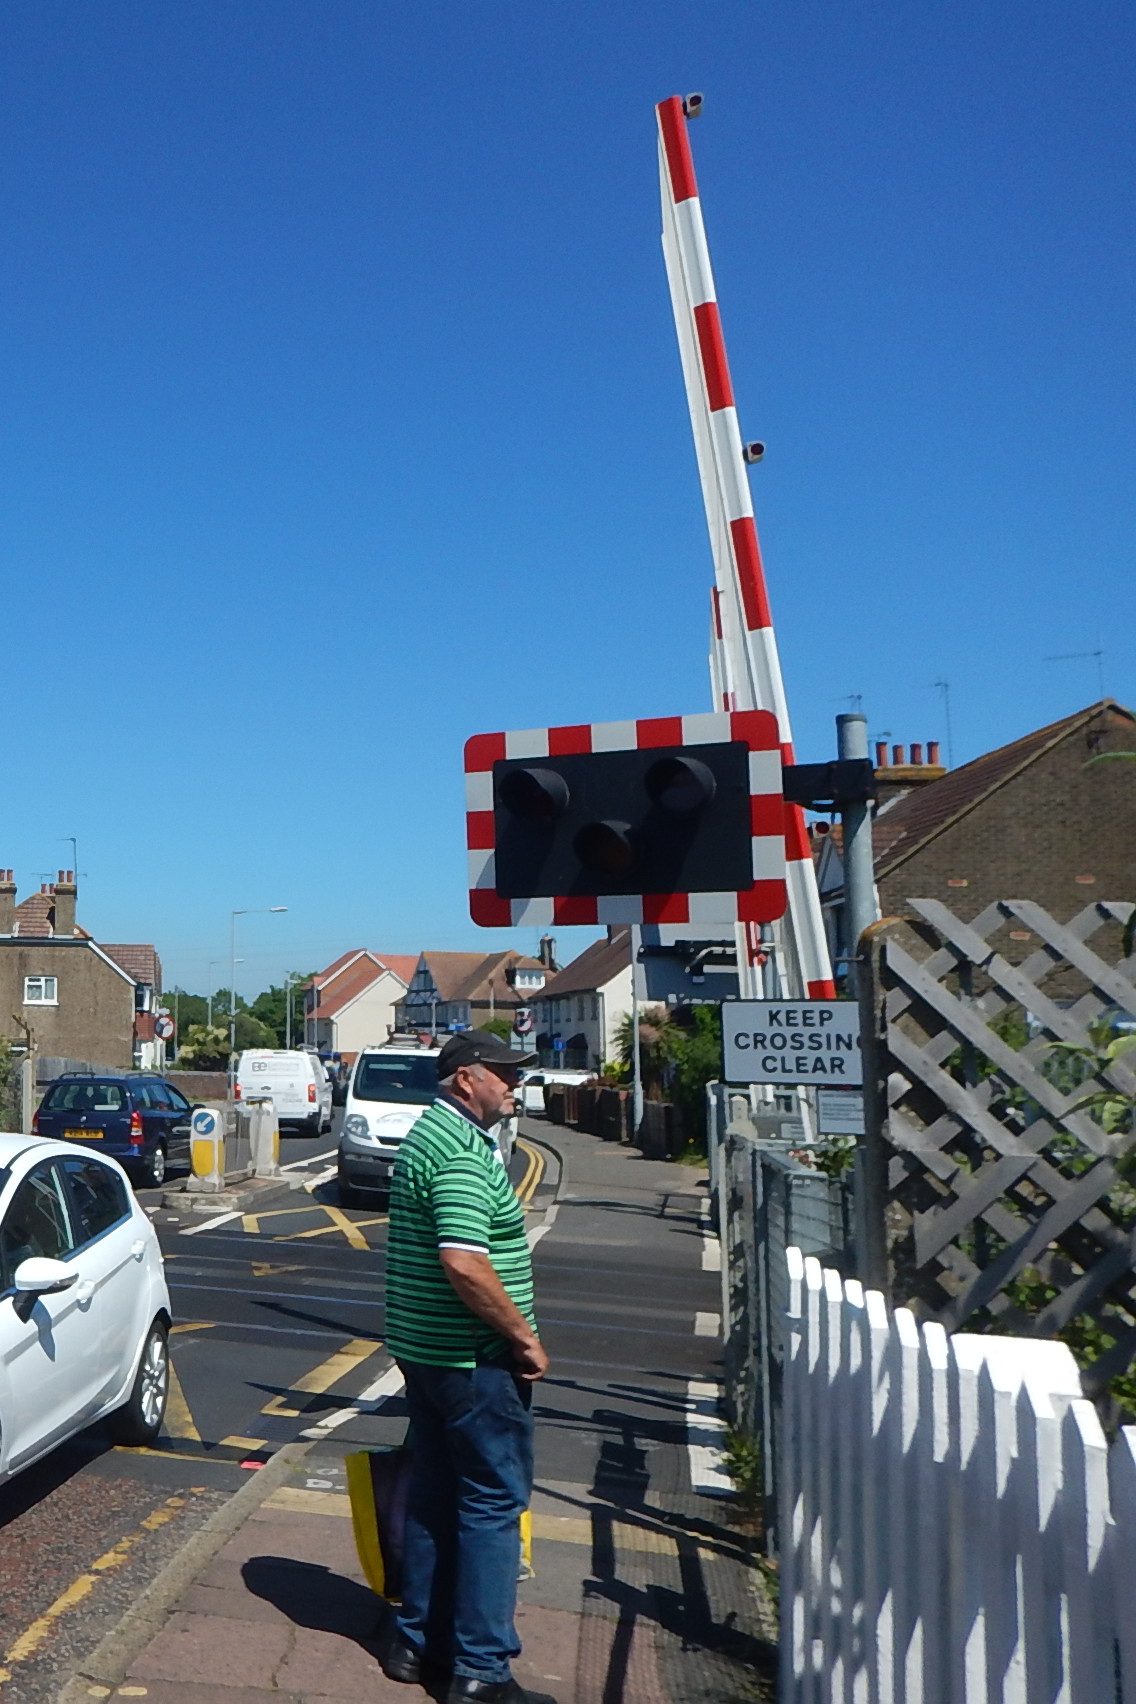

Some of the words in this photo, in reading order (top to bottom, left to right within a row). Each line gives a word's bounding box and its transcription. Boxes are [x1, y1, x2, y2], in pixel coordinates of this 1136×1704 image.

[768, 1009, 833, 1028] KEEP
[734, 1032, 862, 1051] CROSSIN
[761, 1055, 846, 1075] CLEAR
